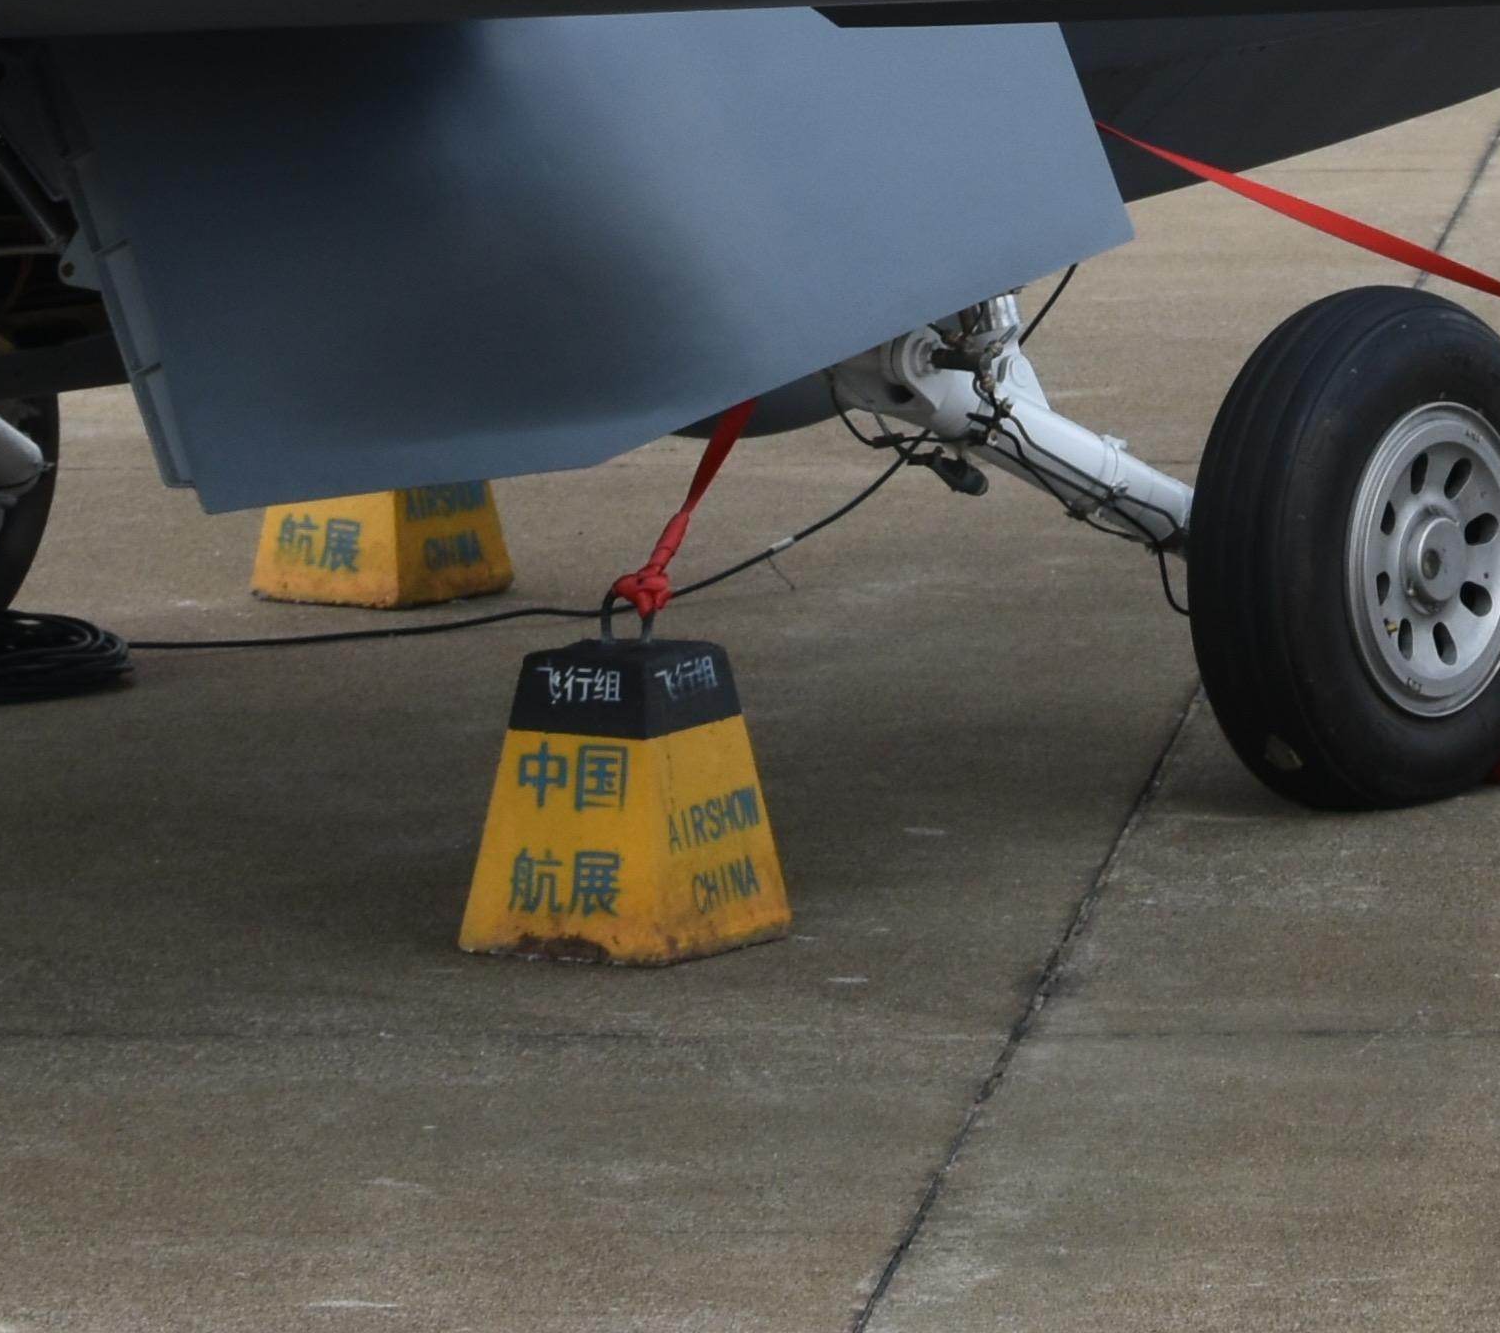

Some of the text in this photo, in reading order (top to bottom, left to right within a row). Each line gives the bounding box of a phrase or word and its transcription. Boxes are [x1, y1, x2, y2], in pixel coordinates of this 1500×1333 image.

[275, 513, 362, 573] 航展
[536, 664, 622, 705] 飞行组
[655, 654, 719, 701] 飞行组
[517, 741, 629, 812] 中国
[667, 786, 762, 855] AIRSHOW
[508, 846, 624, 918] 航展
[691, 854, 762, 916] CHINA
